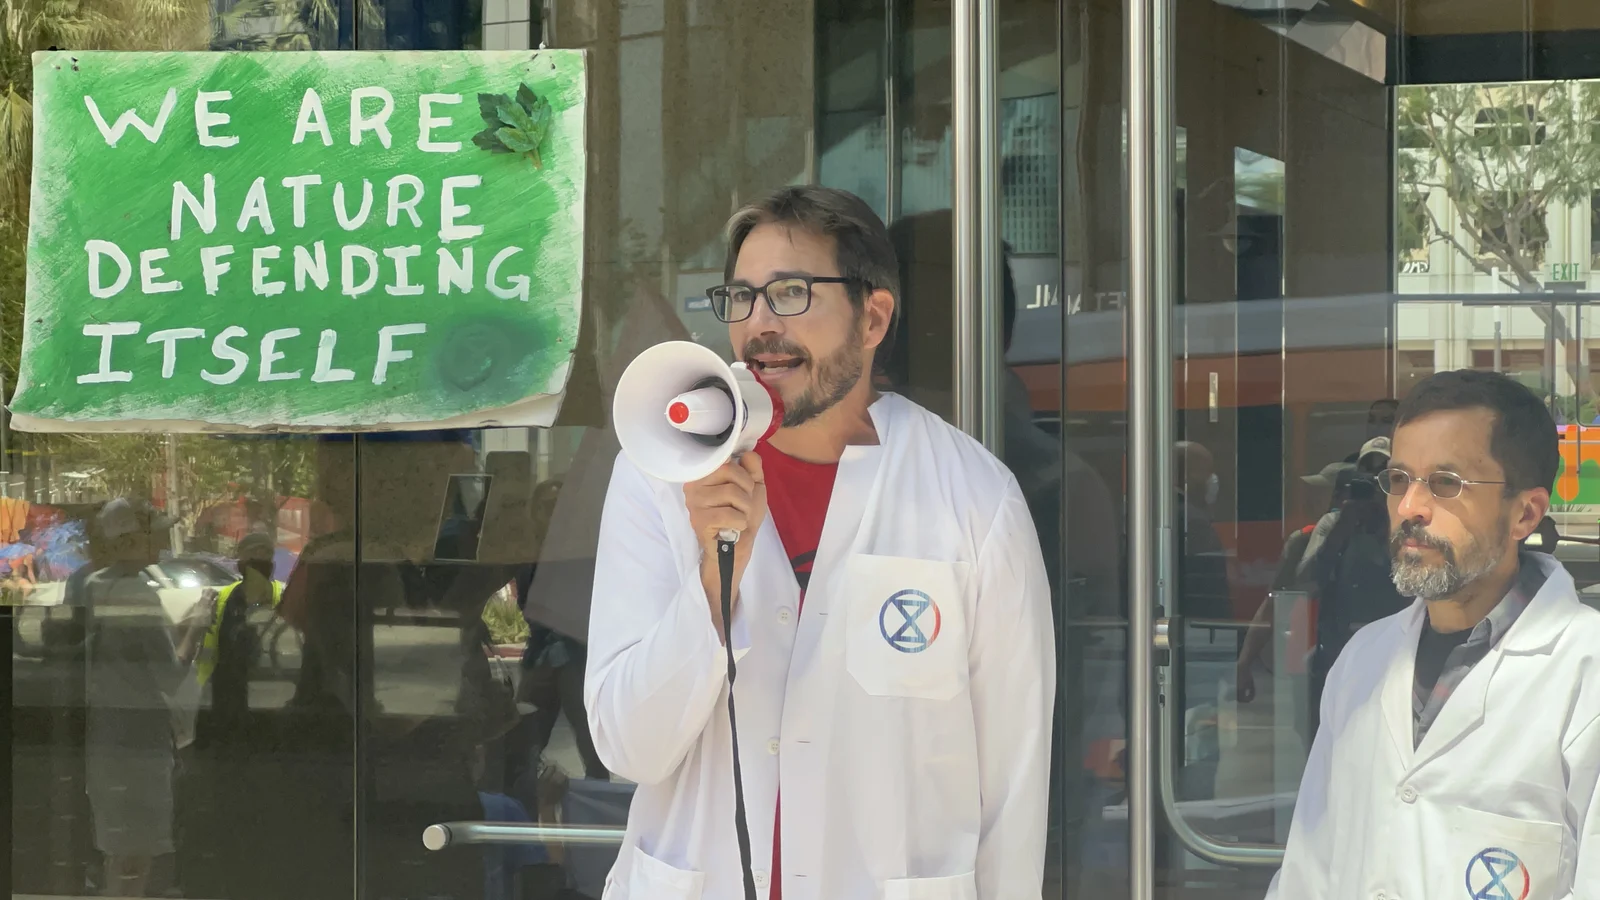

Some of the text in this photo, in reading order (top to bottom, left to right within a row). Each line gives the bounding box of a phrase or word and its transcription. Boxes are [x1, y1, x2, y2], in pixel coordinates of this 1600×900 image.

[84, 86, 463, 153] WE ARE
[170, 173, 484, 244] NATURE
[85, 239, 530, 301] DEFENDING
[1552, 263, 1580, 281] EXIT
[77, 322, 426, 385] ITSELF
